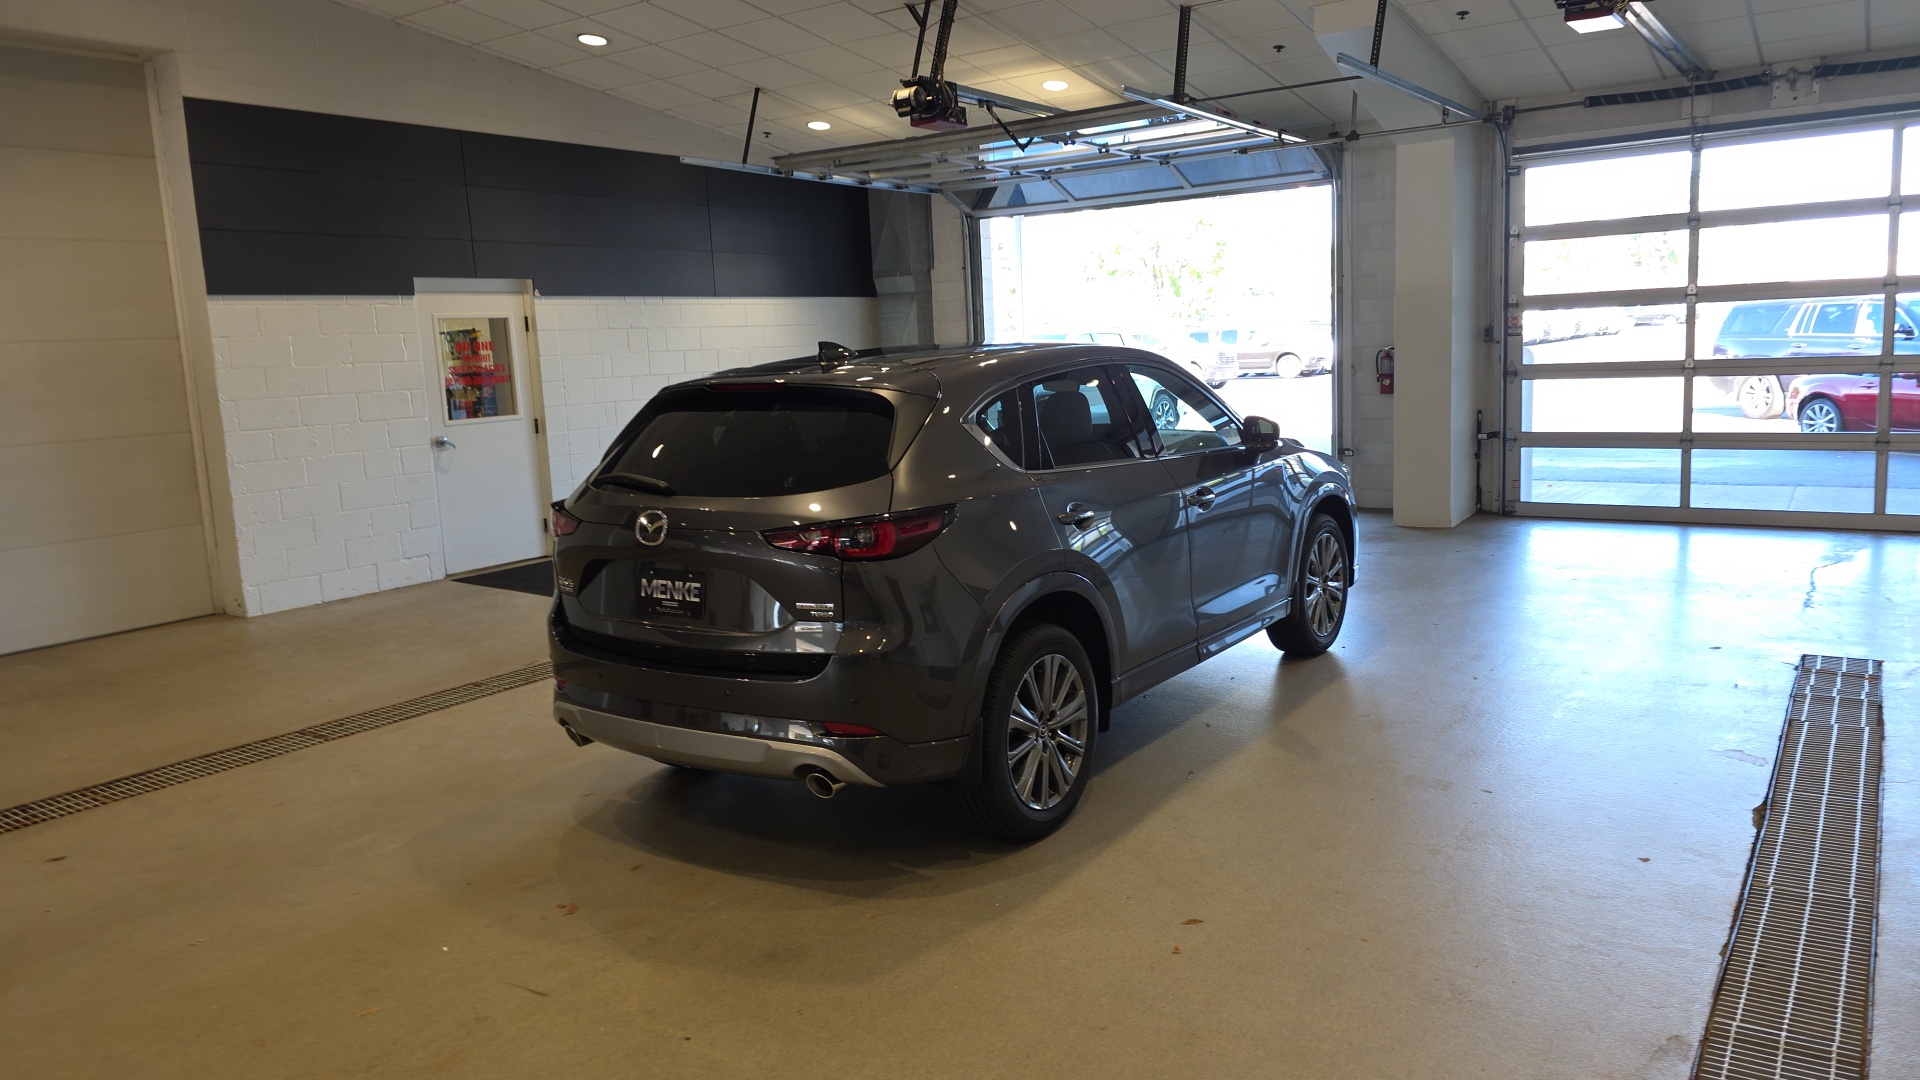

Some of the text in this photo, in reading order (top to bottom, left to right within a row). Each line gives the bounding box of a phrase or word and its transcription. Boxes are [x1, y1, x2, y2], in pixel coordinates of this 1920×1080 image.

[455, 340, 494, 352] NO ONE
[640, 577, 702, 603] MENKE
